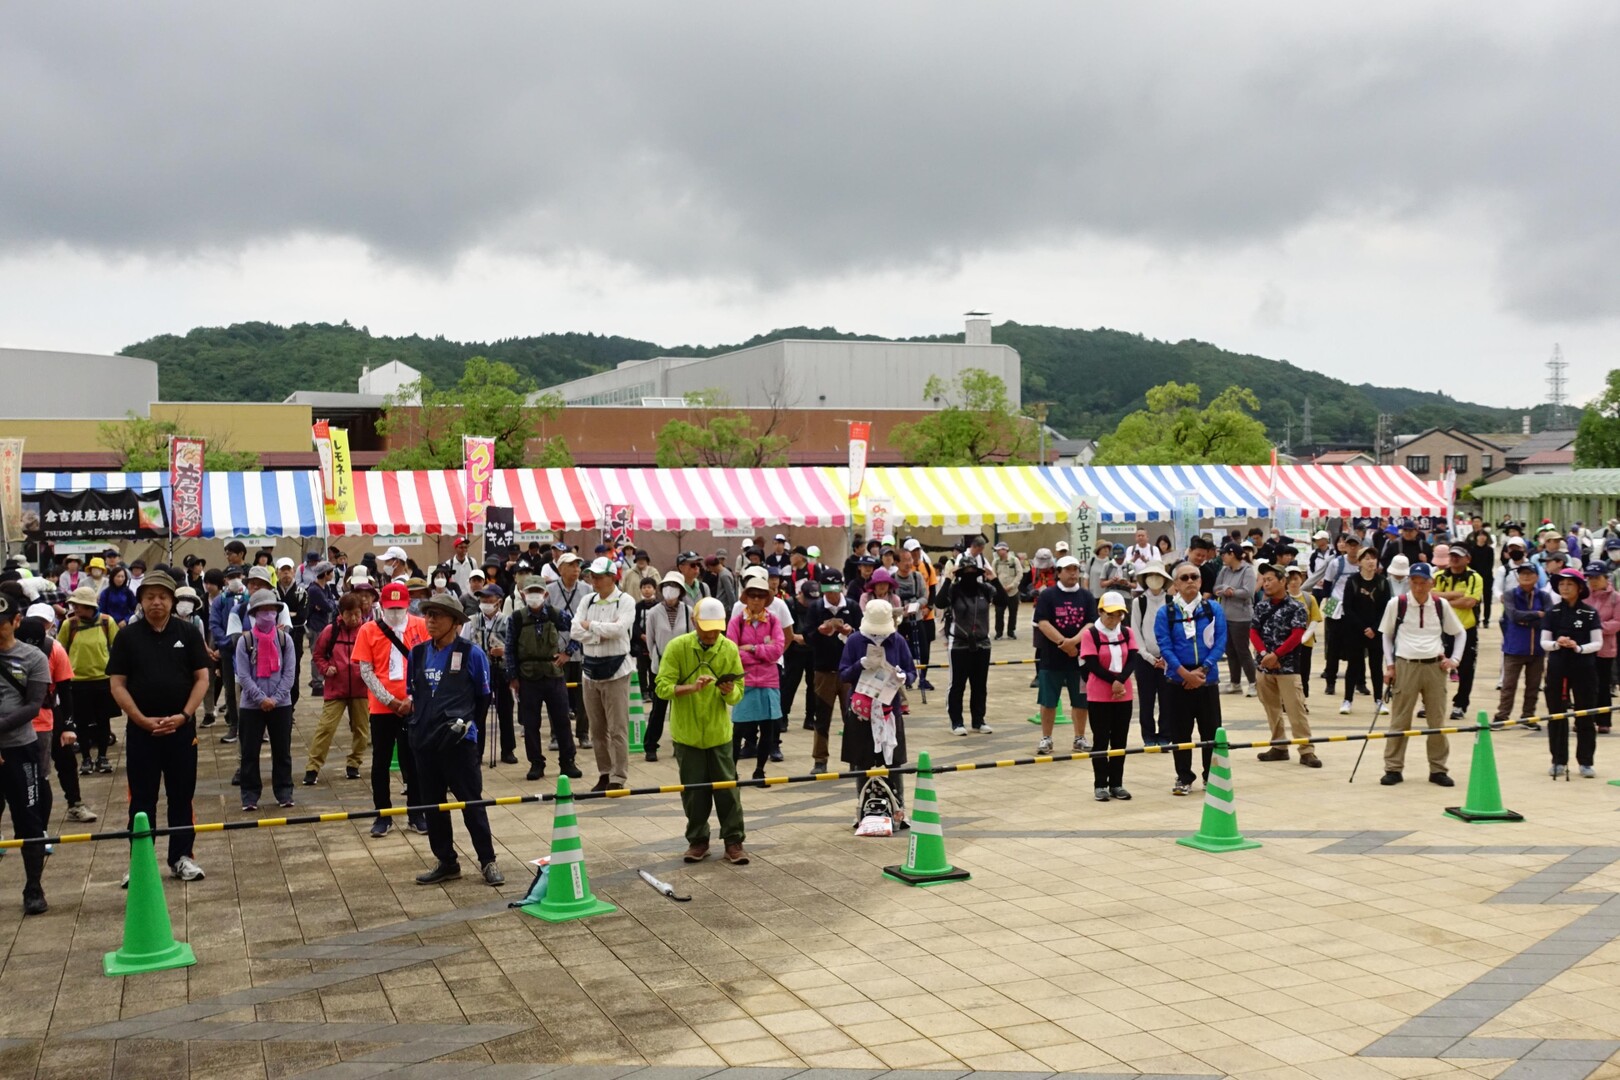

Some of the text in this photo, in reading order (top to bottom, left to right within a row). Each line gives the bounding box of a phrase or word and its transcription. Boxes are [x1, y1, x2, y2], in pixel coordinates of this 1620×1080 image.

[334, 440, 347, 496] レモネード
[470, 444, 490, 519] クレープ
[44, 508, 135, 523] 倉吉銀座唐揚げ
[174, 463, 201, 535] 唐揚げ
[486, 531, 513, 547] キムチ
[1076, 501, 1092, 562] 倉吉市
